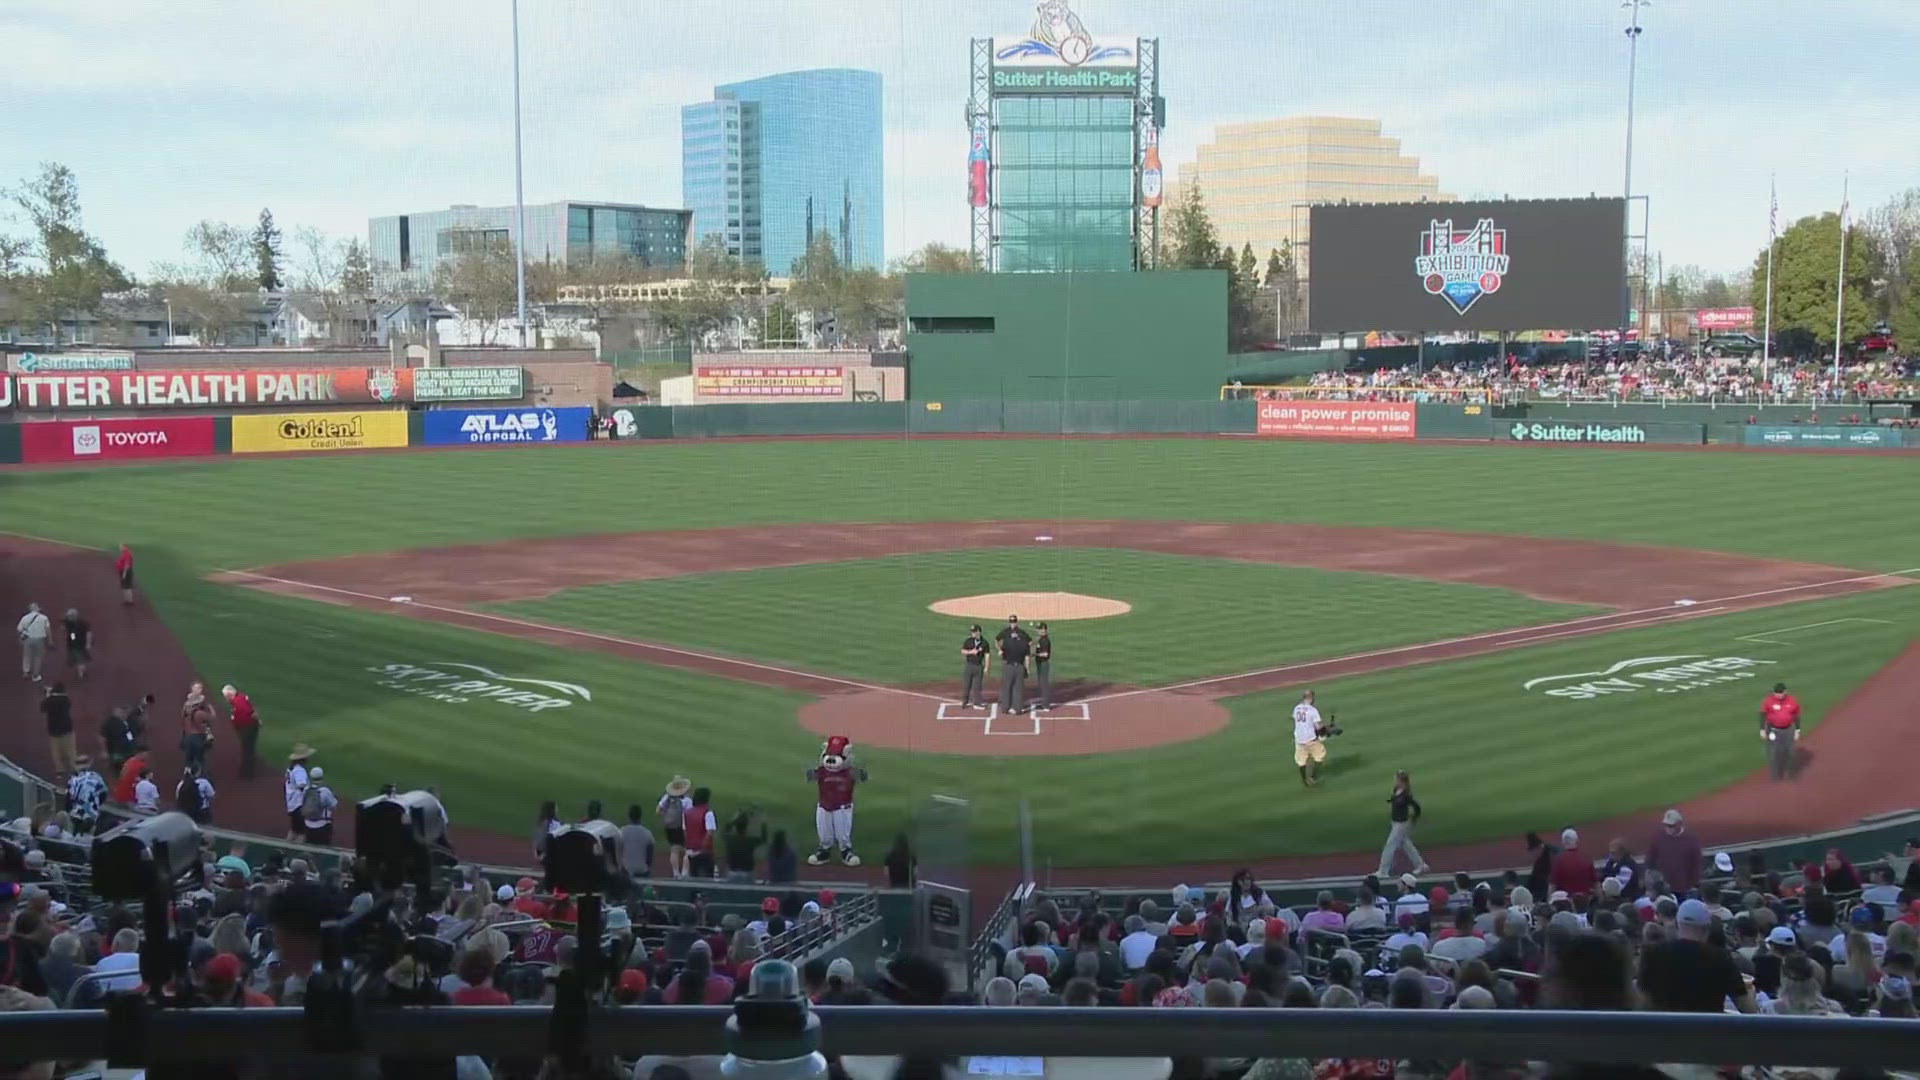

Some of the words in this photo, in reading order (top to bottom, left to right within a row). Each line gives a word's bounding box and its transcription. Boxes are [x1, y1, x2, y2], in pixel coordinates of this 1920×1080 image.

[993, 72, 1043, 87] Sutter
[1046, 72, 1097, 87] Health
[1100, 72, 1137, 87] Park
[1416, 255, 1508, 275] EXHIBITION
[1446, 273, 1478, 283] GAME
[41, 358, 83, 368] Sutter
[84, 358, 132, 369] Health
[122, 374, 247, 406] HEALTH
[256, 373, 334, 403] PARK
[452, 385, 472, 395] BEAT
[474, 385, 488, 394] THE
[1261, 405, 1297, 419] clean
[1301, 408, 1347, 422] power
[1351, 407, 1410, 424] promise
[460, 413, 540, 434] ATLAS
[106, 431, 168, 446] TOYOTA
[470, 431, 533, 442] DISPOSAL
[1530, 424, 1585, 440] Sutter
[1586, 424, 1645, 442] Health
[311, 440, 336, 448] Credit
[340, 439, 364, 447] Union
[523, 930, 551, 958] 27
